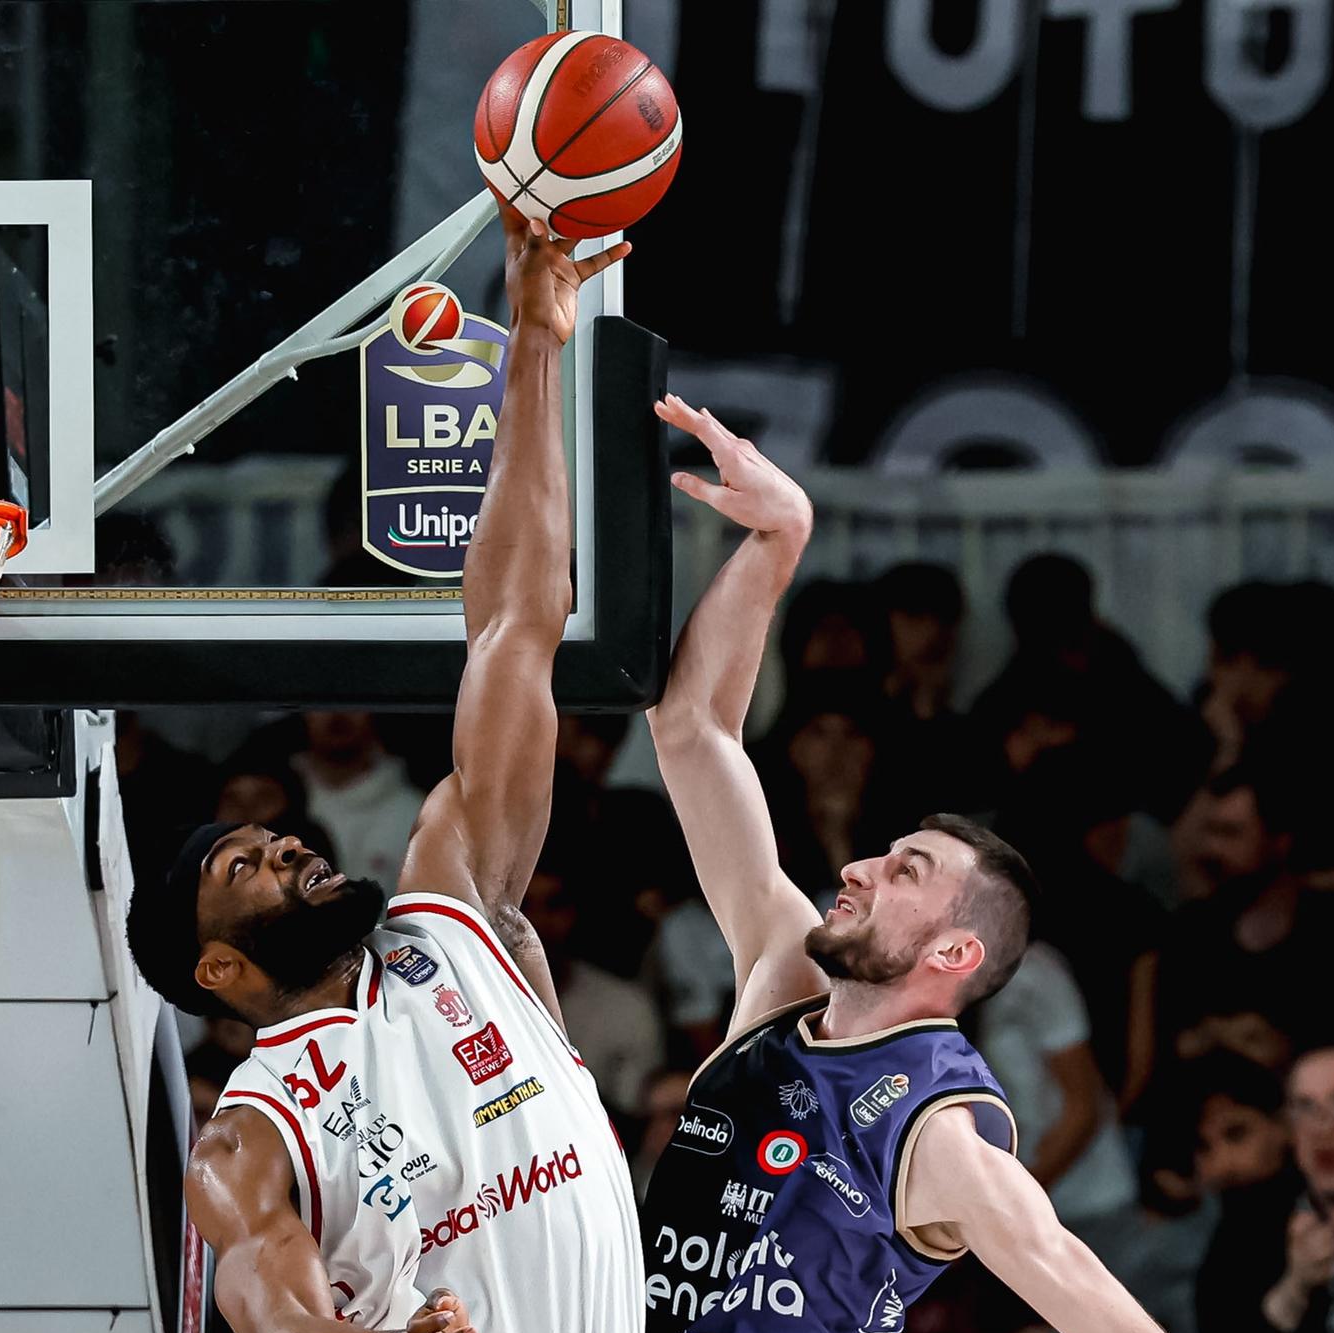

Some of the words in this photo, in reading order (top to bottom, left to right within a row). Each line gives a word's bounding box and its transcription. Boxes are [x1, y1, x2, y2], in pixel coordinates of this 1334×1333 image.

[385, 404, 498, 448] LBA
[407, 460, 463, 474] SERIE
[468, 459, 483, 473] A
[399, 503, 478, 547] Unip
[471, 1050, 511, 1081] EYEWEAR
[473, 1077, 544, 1127] SIMMENTHAL
[677, 1115, 730, 1143] elinda
[747, 1187, 775, 1213] IT
